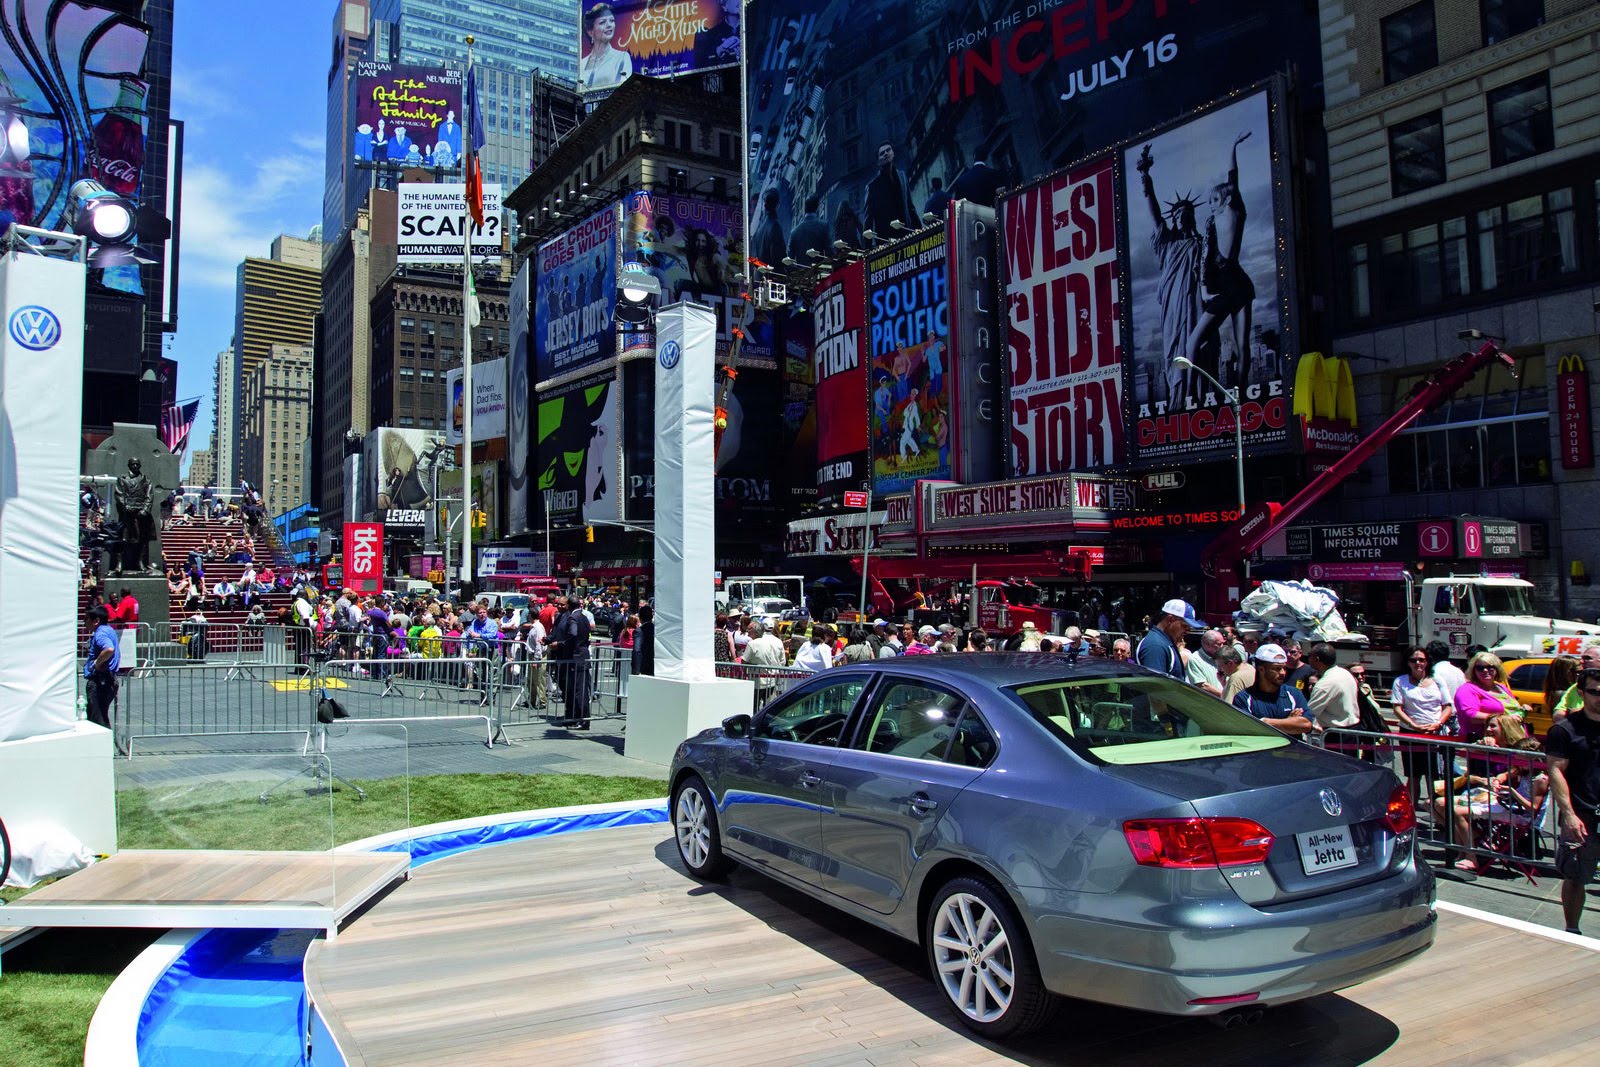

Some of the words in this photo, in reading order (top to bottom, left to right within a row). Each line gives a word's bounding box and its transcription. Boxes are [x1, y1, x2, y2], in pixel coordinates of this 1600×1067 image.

[654, 0, 699, 21] LITTLE
[618, 17, 668, 48] NIGHT
[656, 18, 708, 44] MUSIC
[948, 28, 988, 53] FROM
[993, 10, 1021, 34] THE
[950, 0, 1168, 103] INCEP
[358, 61, 392, 71] NATHAN
[358, 69, 378, 78] LANE
[446, 70, 461, 78] BEBE
[1060, 49, 1135, 101] JULY
[1142, 33, 1179, 68] 16
[393, 79, 427, 90] The
[372, 86, 447, 106] Addams
[379, 102, 442, 128] Family
[404, 193, 420, 201] THE
[627, 193, 670, 217] LOVE
[676, 200, 715, 224] OUT
[400, 215, 499, 236] SCAM?
[567, 209, 614, 246] CROWD
[1004, 156, 1118, 286] WEST
[903, 243, 920, 260] TONY
[919, 231, 945, 253] AWARDS
[543, 246, 575, 273] GOES
[871, 267, 887, 286] BEST
[888, 255, 918, 281] MUSICAL
[871, 263, 946, 323] SOUTH
[545, 308, 581, 354] JERSEY
[582, 299, 609, 340] BOYS
[871, 301, 947, 358] PACIFIC
[973, 220, 992, 421] PALACE
[1006, 259, 1122, 388] SIDE
[554, 348, 571, 362] BEST
[570, 338, 599, 355] MUSICAL
[476, 384, 495, 394] When
[1138, 400, 1168, 419] AT
[1185, 379, 1284, 411] LARGE
[1566, 378, 1577, 411] OPEN
[476, 395, 489, 405] Dad
[476, 406, 488, 417] you
[1009, 378, 1124, 478] STORY
[1136, 397, 1287, 448] CHICAGO
[1234, 429, 1287, 443] 22-239-6200
[1306, 426, 1360, 444] McDonald's
[1568, 422, 1580, 463] HOURS
[823, 463, 834, 483] THE
[835, 460, 853, 480] END
[900, 468, 925, 479] CENTER
[1147, 472, 1179, 488] FUEL
[543, 489, 578, 512] WICKED
[943, 489, 978, 517] WEST
[980, 485, 1016, 514] SIDE
[1020, 479, 1064, 511] STORY
[1077, 479, 1109, 508] WEST
[385, 509, 425, 522] LEVERA
[1112, 515, 1165, 529] WELCOME
[1167, 513, 1183, 525] TO
[1184, 510, 1219, 524] TIMES
[1322, 527, 1355, 538] TIMES
[1357, 524, 1401, 537] SQUARE
[1484, 525, 1498, 535] TIMES
[1498, 525, 1518, 536] SQUARE
[1485, 535, 1517, 545] INFORMATION
[353, 527, 378, 574] tkts
[1324, 536, 1399, 549] INFORMATION
[1340, 547, 1382, 559] CENTER
[1492, 545, 1511, 555] CENTER
[1433, 617, 1473, 626] CAPPELLI
[1558, 636, 1583, 655] ME
[1308, 833, 1343, 848] All-New
[1314, 847, 1346, 866] Jetta
[1229, 869, 1261, 879] JETTA
